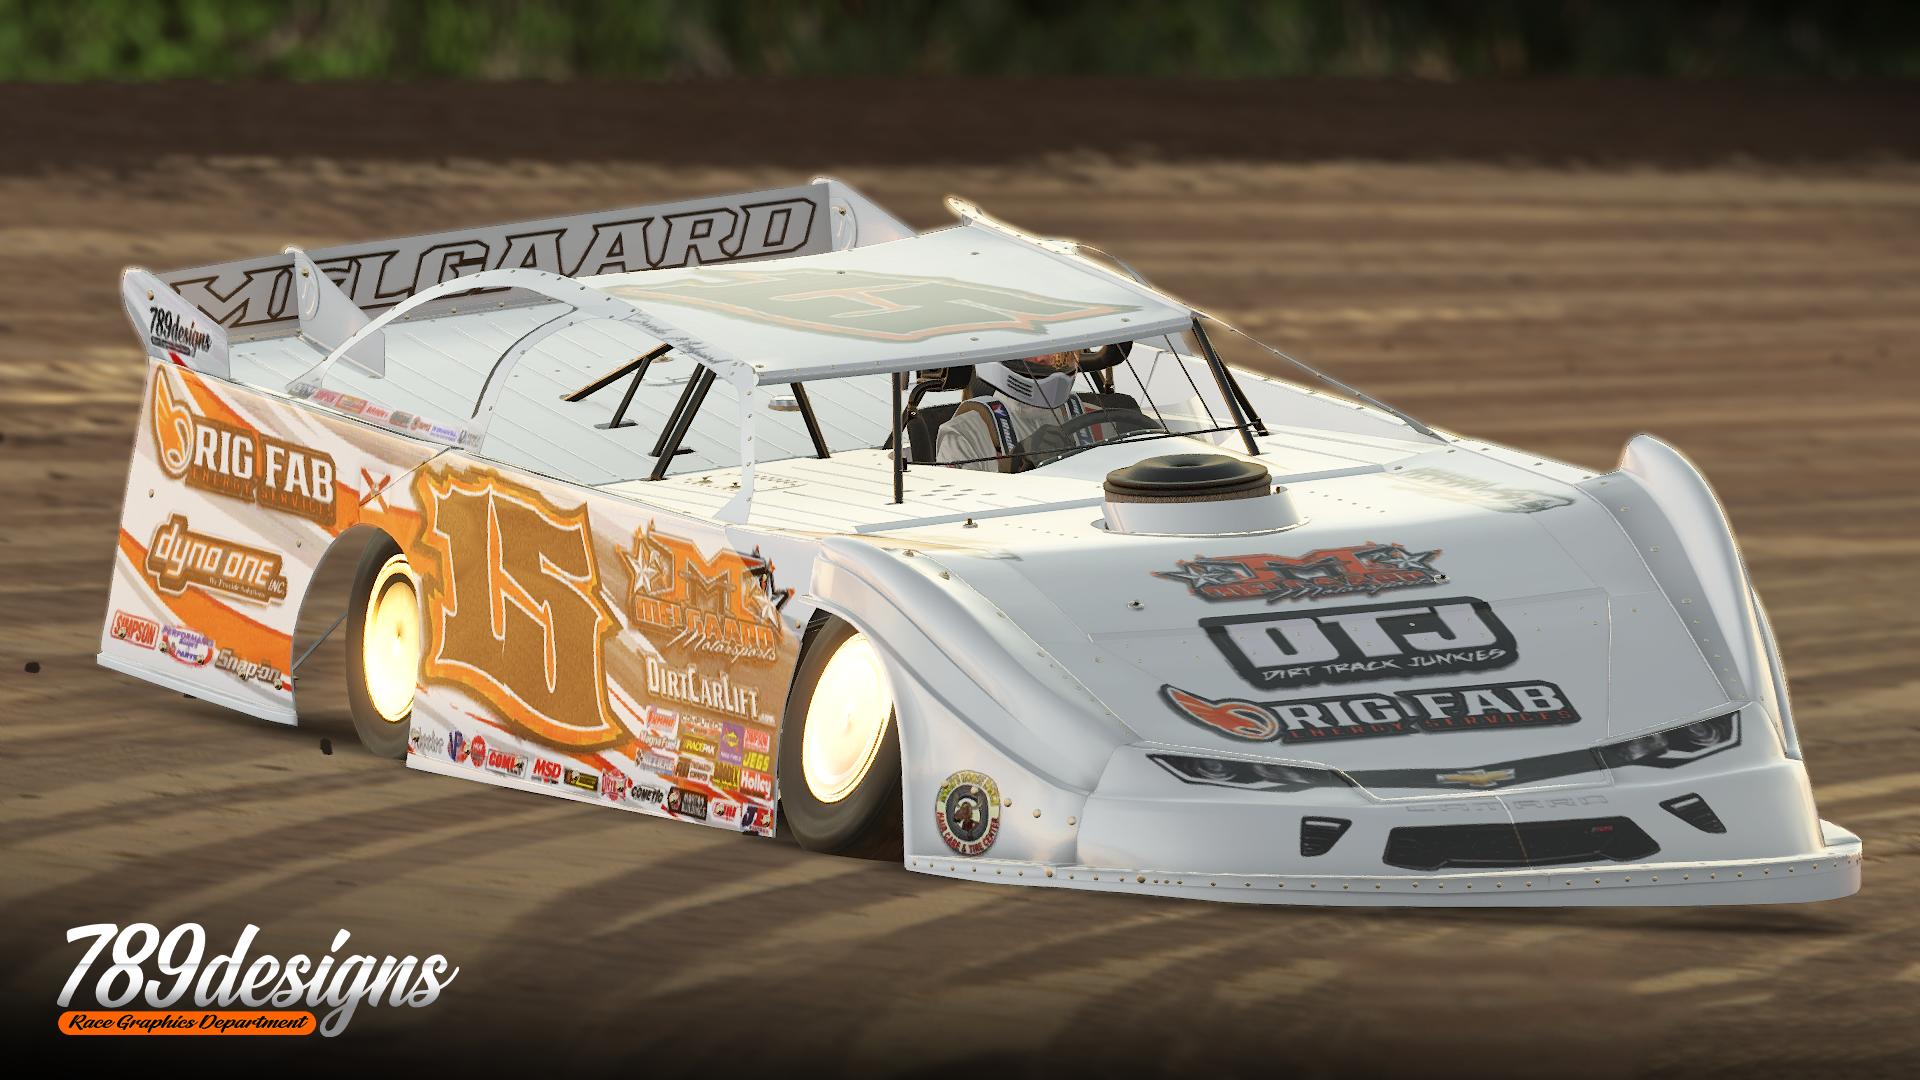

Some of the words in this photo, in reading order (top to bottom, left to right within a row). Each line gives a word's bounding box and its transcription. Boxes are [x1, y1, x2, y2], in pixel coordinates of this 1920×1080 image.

[150, 306, 212, 357] 789designs
[194, 423, 254, 480] RIG
[264, 441, 334, 504] FAB
[154, 526, 220, 577] dyno
[424, 480, 625, 738] 15
[114, 614, 157, 646] SIMPSON
[1225, 602, 1497, 668] DTJ
[1262, 666, 1315, 681] DIRT
[1319, 659, 1402, 674] TRACK
[1408, 648, 1506, 668] JUNKIES
[1272, 698, 1402, 731] RIG
[1414, 685, 1565, 719] FAB
[1424, 710, 1574, 728] SERVICES
[534, 758, 562, 779] MSD
[742, 752, 770, 771] JEGS
[741, 769, 772, 797] Holley
